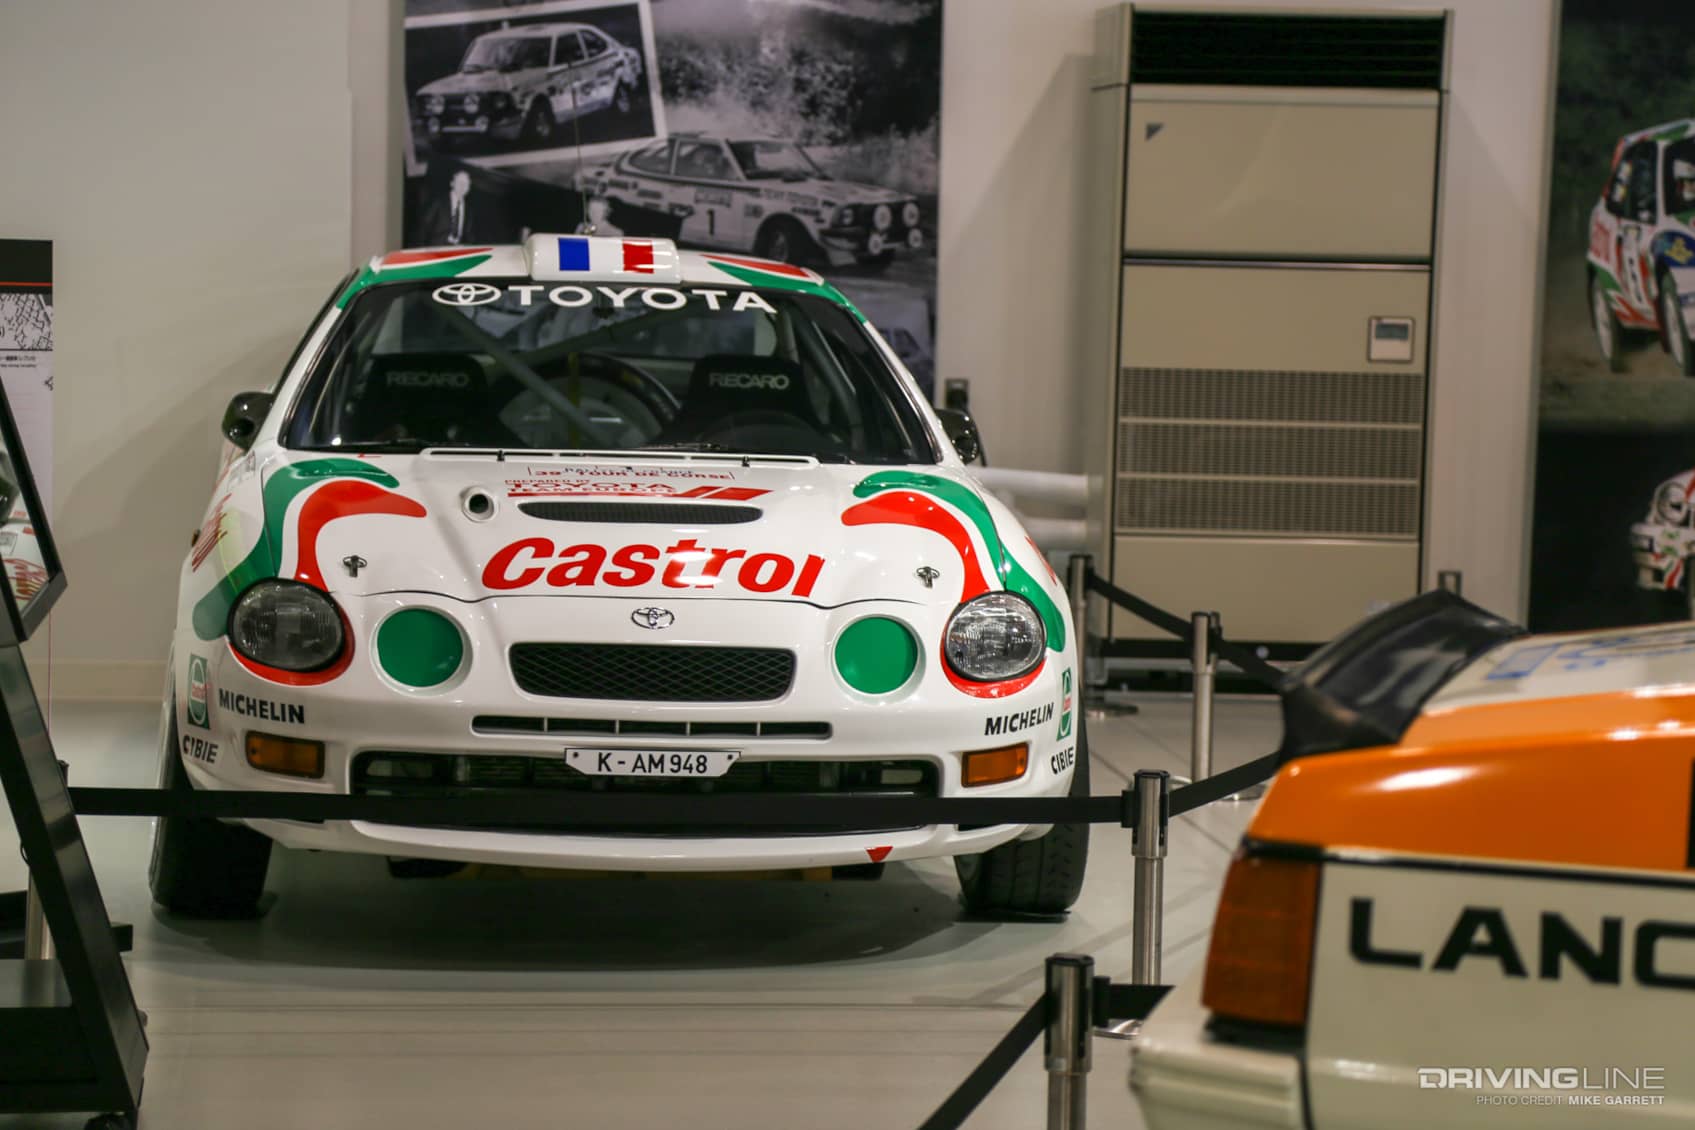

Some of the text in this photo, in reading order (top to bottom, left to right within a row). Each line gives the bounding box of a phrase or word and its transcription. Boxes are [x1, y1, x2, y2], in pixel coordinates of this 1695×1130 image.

[707, 209, 716, 235] 1
[508, 285, 777, 314] TOYOTA
[385, 371, 470, 388] RECARO
[709, 373, 790, 390] RECARO
[482, 537, 825, 597] Castrol
[218, 688, 305, 724] MICHELIN
[984, 702, 1055, 736] MICHELIN
[183, 734, 219, 765] CIBIE
[1051, 746, 1075, 775] CIBIE
